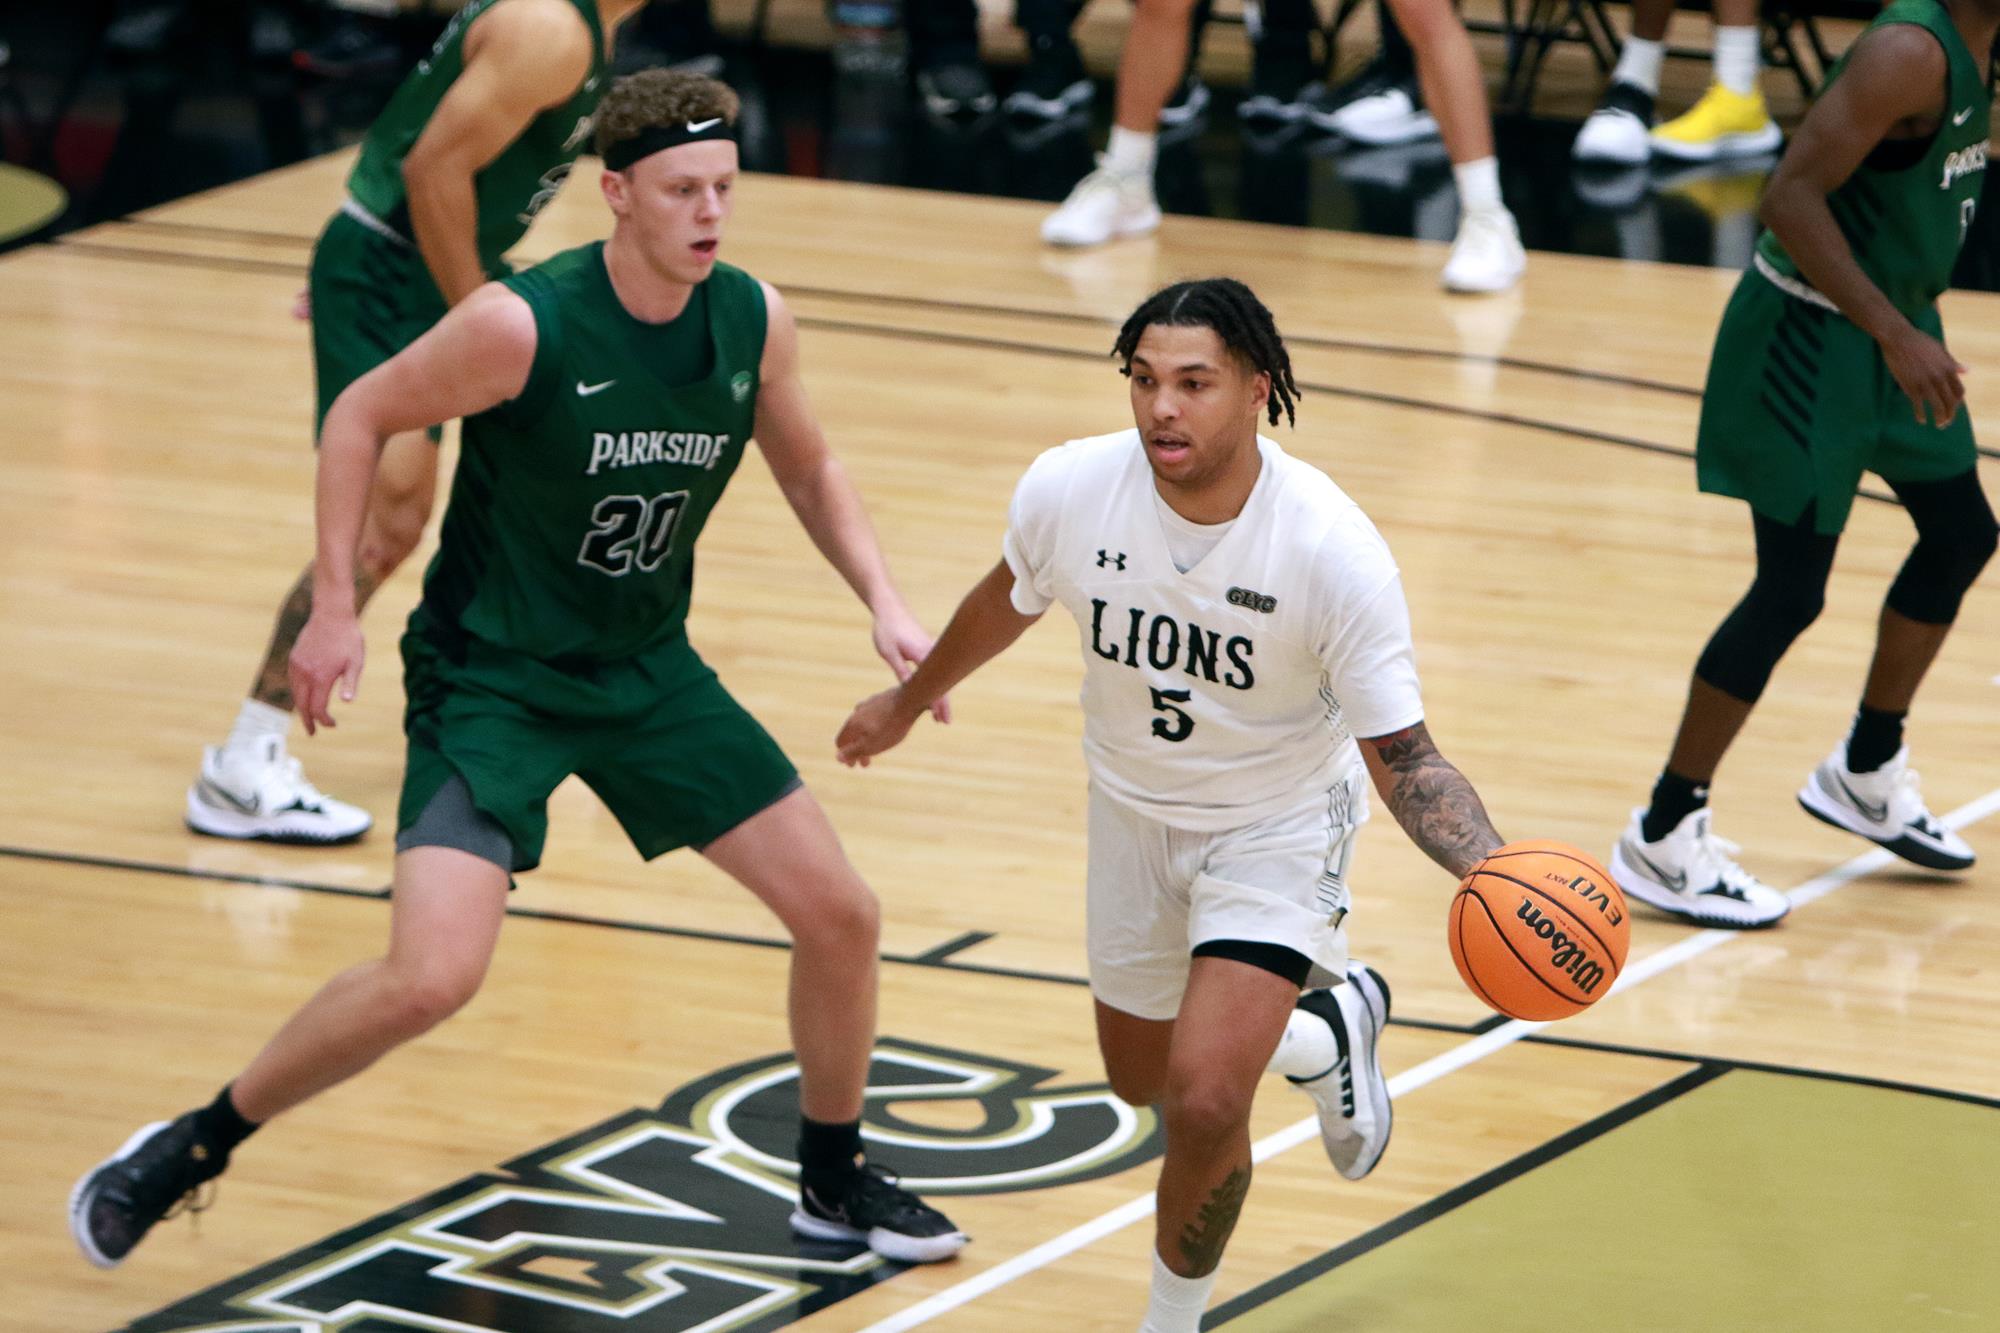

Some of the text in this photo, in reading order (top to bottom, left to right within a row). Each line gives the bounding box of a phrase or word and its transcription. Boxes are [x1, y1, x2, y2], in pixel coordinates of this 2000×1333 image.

[585, 430, 730, 476] PARKSIDE
[576, 488, 691, 579] 20
[1090, 598, 1255, 690] LIONS
[1149, 685, 1196, 743] 5
[1544, 871, 1623, 928] EVO NXT
[1516, 898, 1605, 996] Wilson
[130, 1048, 1150, 1333] LVC
